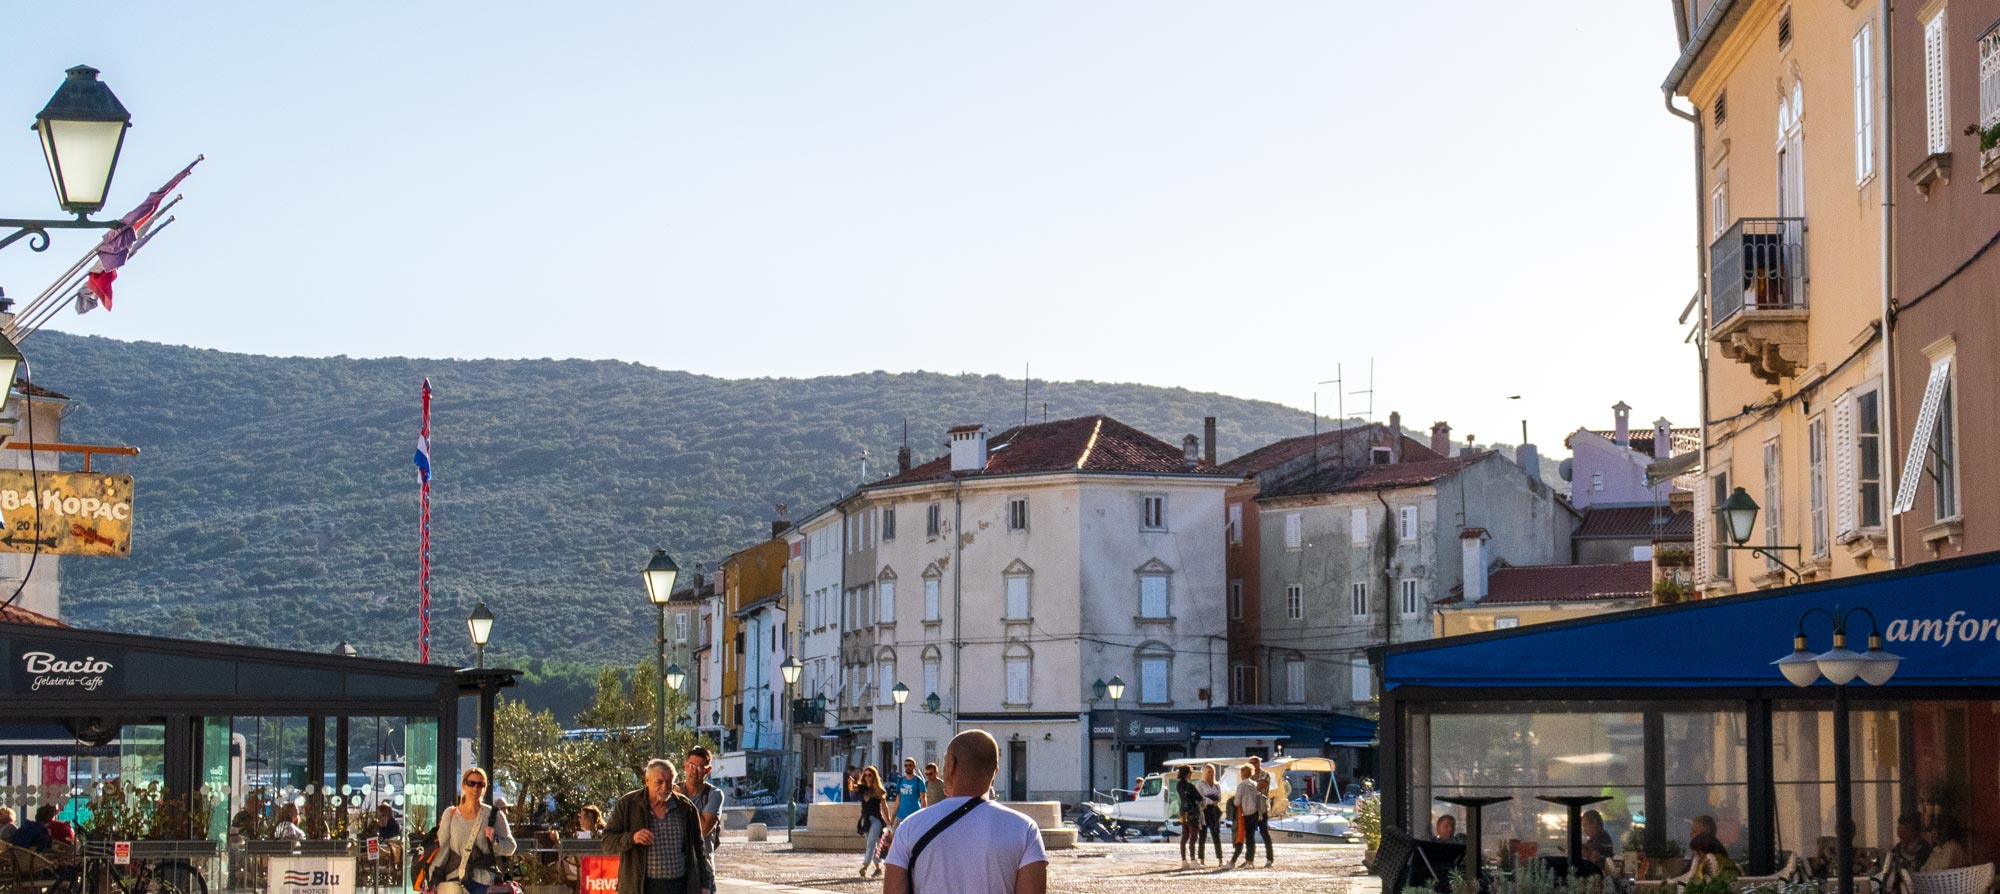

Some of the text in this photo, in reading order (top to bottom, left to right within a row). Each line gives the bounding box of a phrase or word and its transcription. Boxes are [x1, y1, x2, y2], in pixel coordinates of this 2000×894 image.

[0, 489, 130, 521] BA KOPAC
[16, 520, 30, 531] 20
[1885, 610, 2000, 647] amfor
[22, 651, 114, 674] Bacio
[311, 870, 340, 886] Blu
